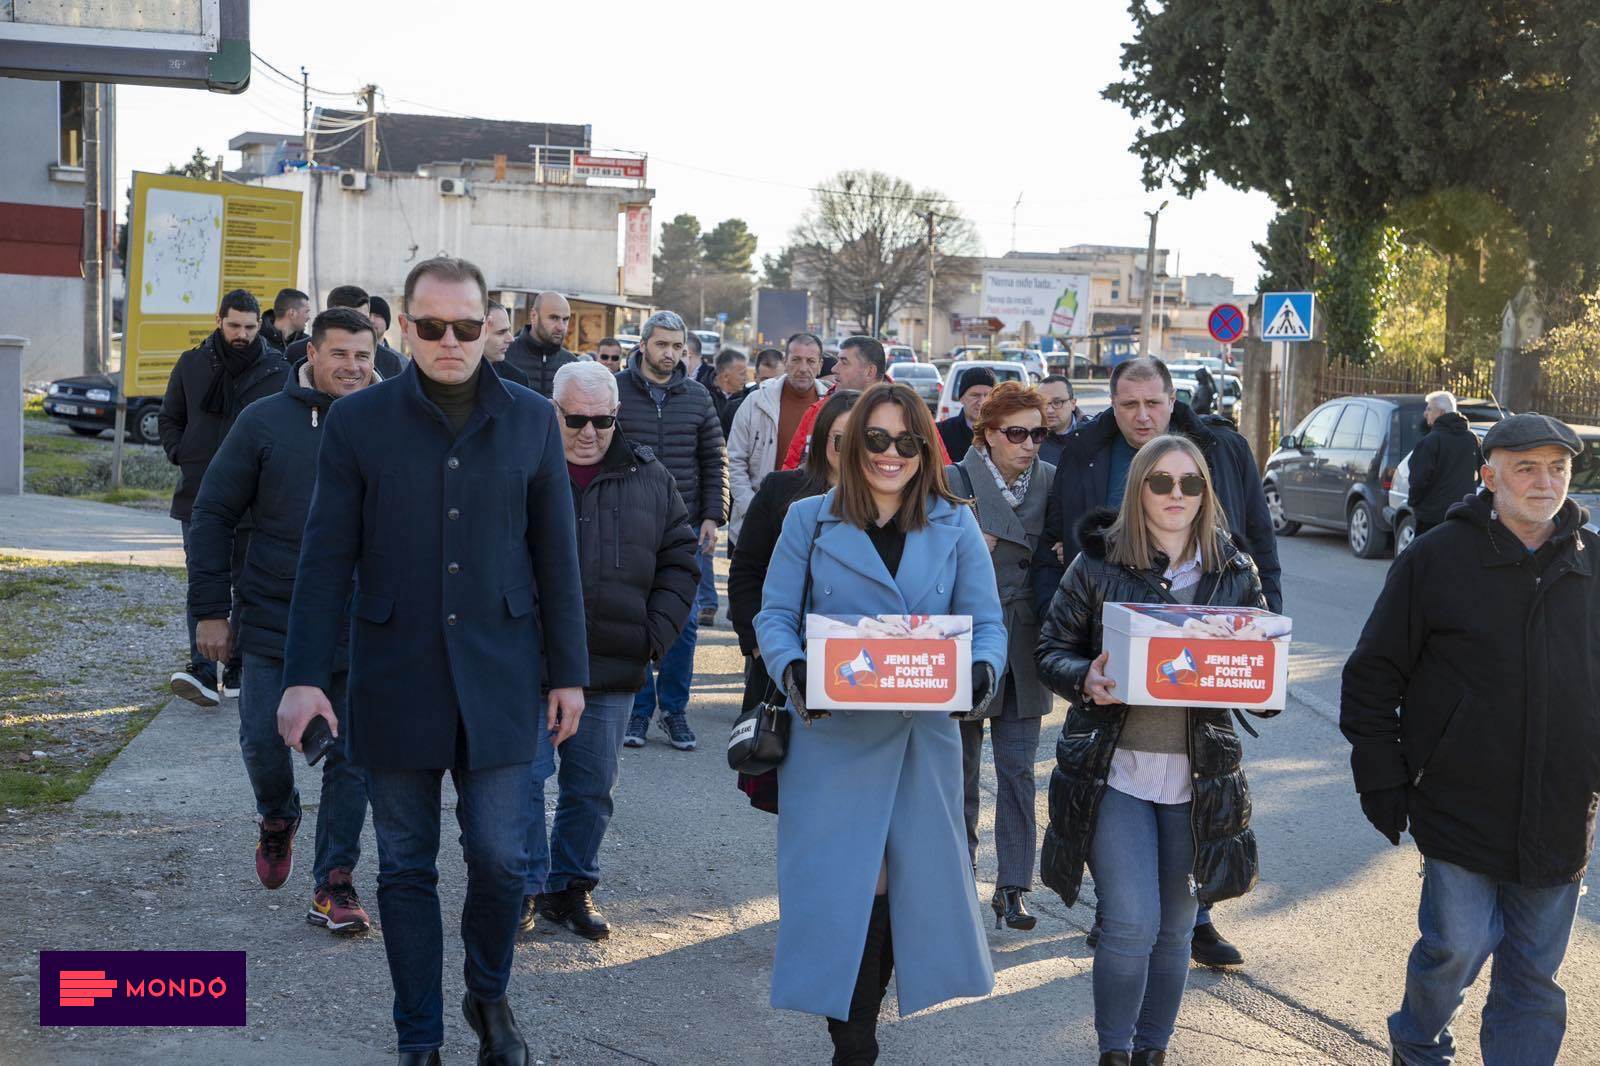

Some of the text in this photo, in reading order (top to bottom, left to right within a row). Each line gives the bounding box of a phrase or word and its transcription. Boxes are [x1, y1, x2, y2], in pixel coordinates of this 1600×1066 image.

[883, 653, 946, 665] JEMI MË TË
[1204, 654, 1265, 667] JEMI MË TË
[895, 665, 934, 677] FORTË
[1215, 665, 1253, 677] FORTË
[880, 675, 949, 689] SË BASHKU!
[1200, 675, 1266, 690] SË BASHKU!
